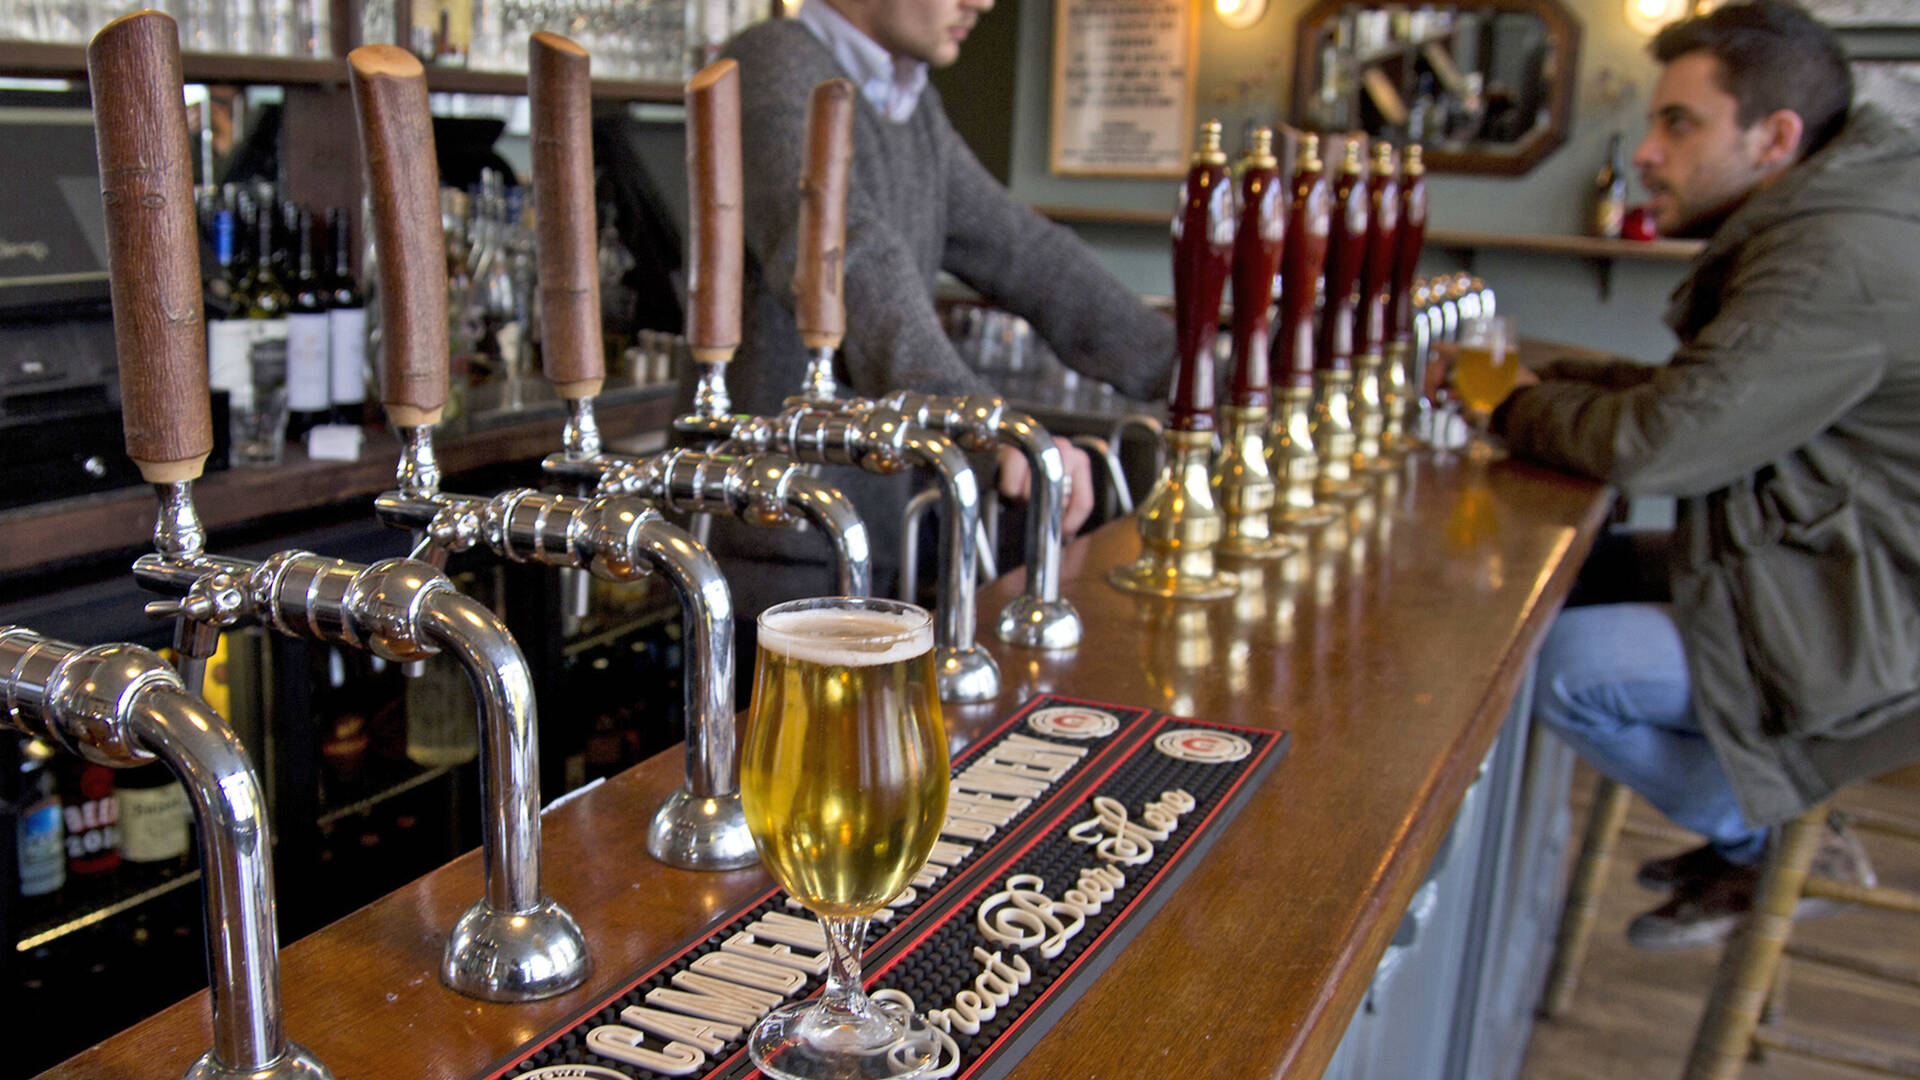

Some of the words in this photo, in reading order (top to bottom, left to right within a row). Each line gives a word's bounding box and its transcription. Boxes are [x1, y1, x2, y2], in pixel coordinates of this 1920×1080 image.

[977, 863, 1126, 959] Beer
[1067, 788, 1197, 866] Here
[586, 911, 845, 1076] CAMDEN
